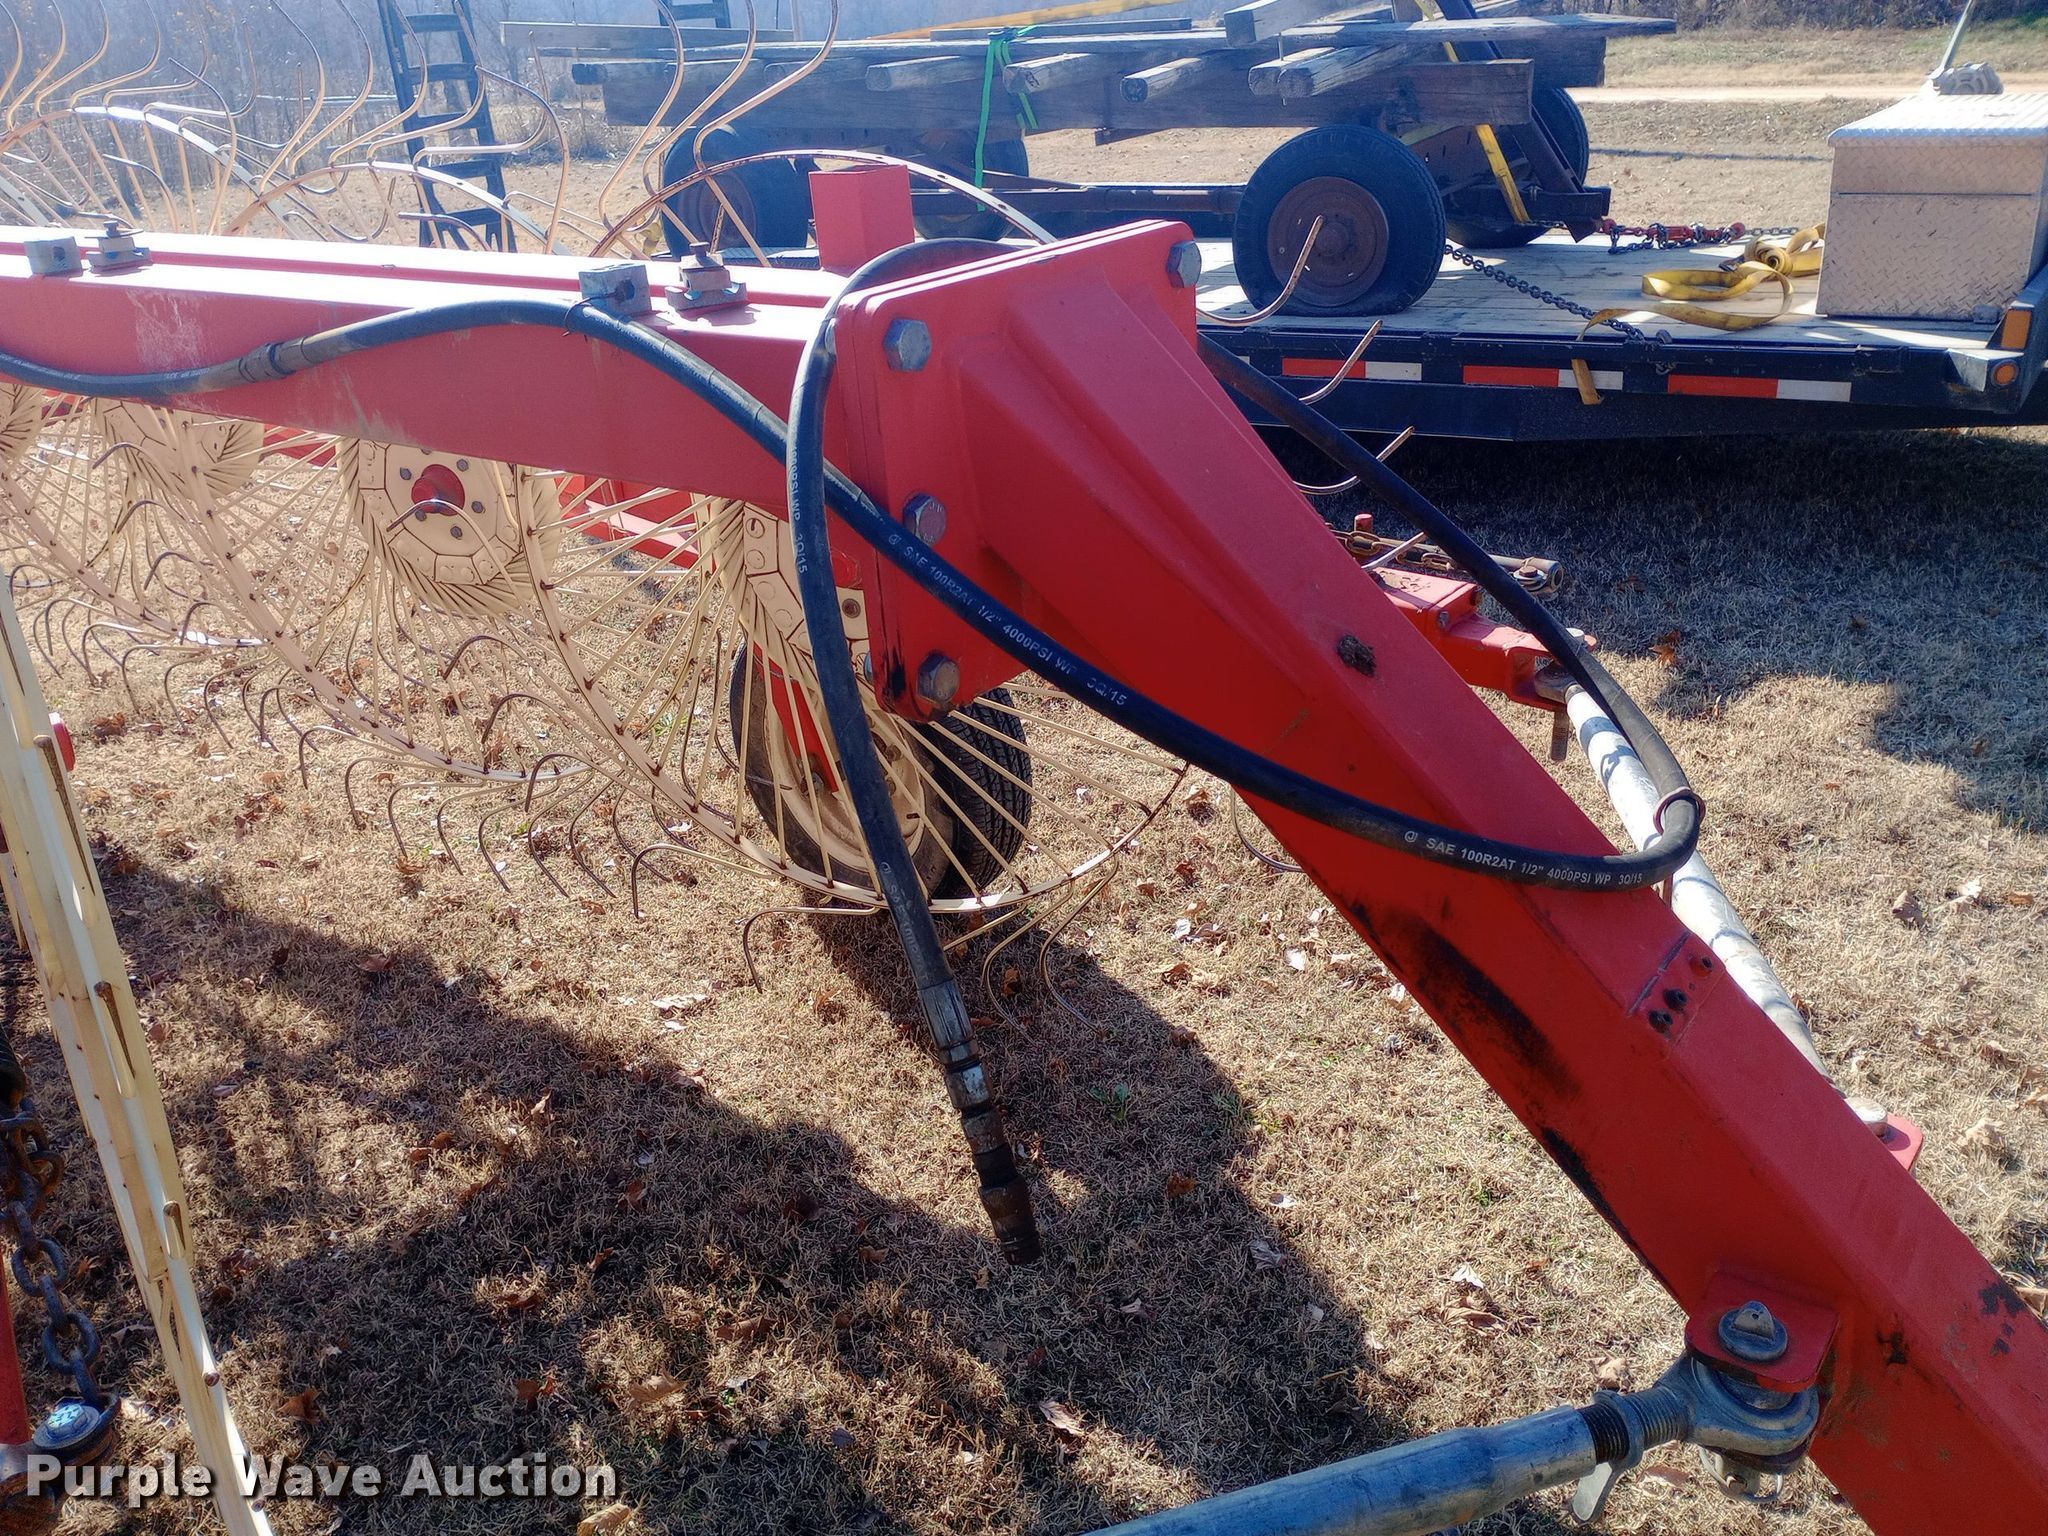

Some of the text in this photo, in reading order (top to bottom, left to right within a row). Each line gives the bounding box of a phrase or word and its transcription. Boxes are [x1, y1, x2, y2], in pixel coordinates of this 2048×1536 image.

[1003, 624, 1053, 662] 4000PSI
[1426, 838, 1456, 856] SAE
[1461, 847, 1516, 871] 100R2AT
[1547, 867, 1591, 884] 4000PSI
[1595, 872, 1611, 885] WP
